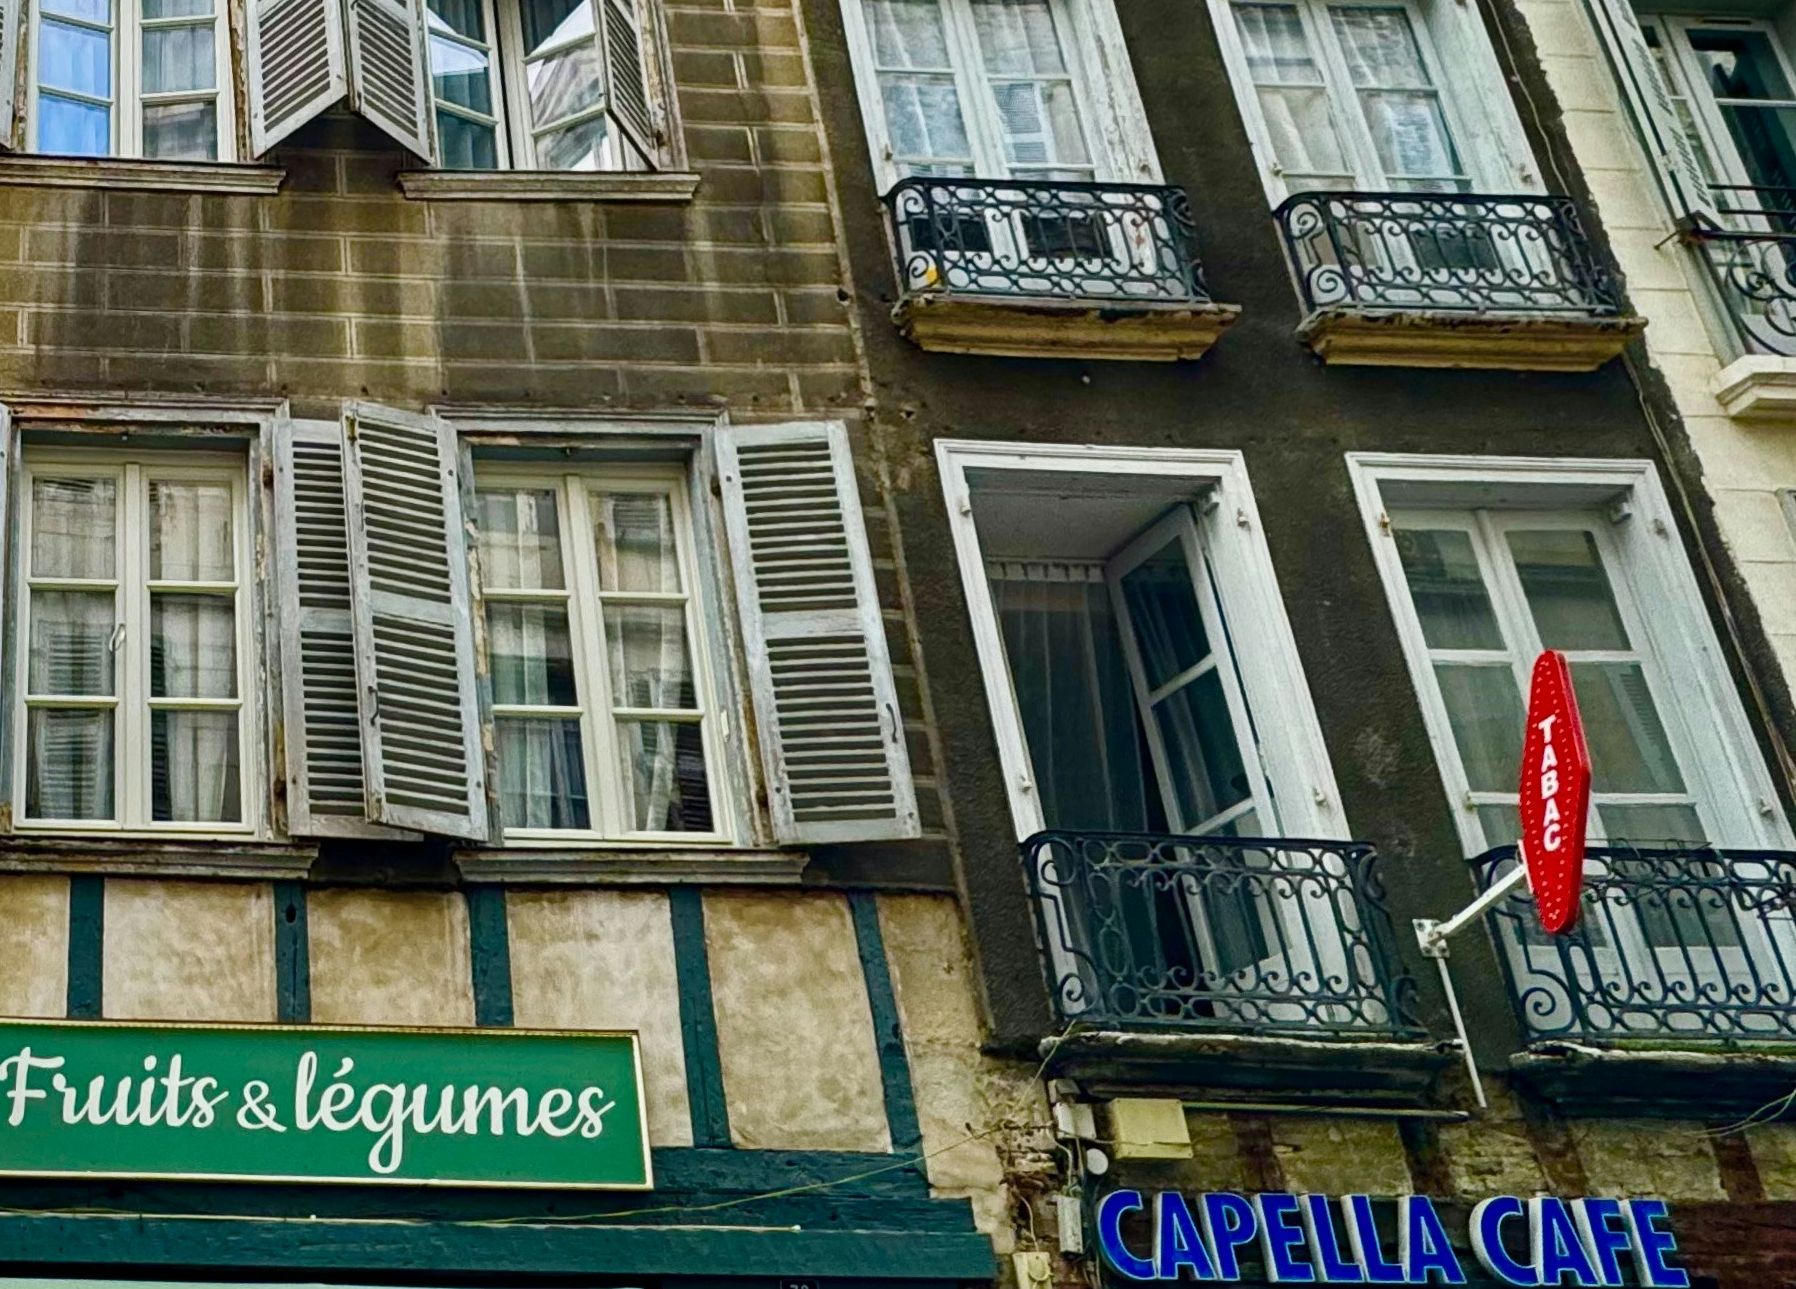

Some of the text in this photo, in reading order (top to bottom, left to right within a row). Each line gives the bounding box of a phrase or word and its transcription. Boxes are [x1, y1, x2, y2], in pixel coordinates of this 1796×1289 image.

[1537, 714, 1562, 852] TABAC
[236, 1079, 287, 1132] &
[295, 1050, 615, 1174] légumes
[1098, 1189, 1690, 1288] CAPELLA CAFE
